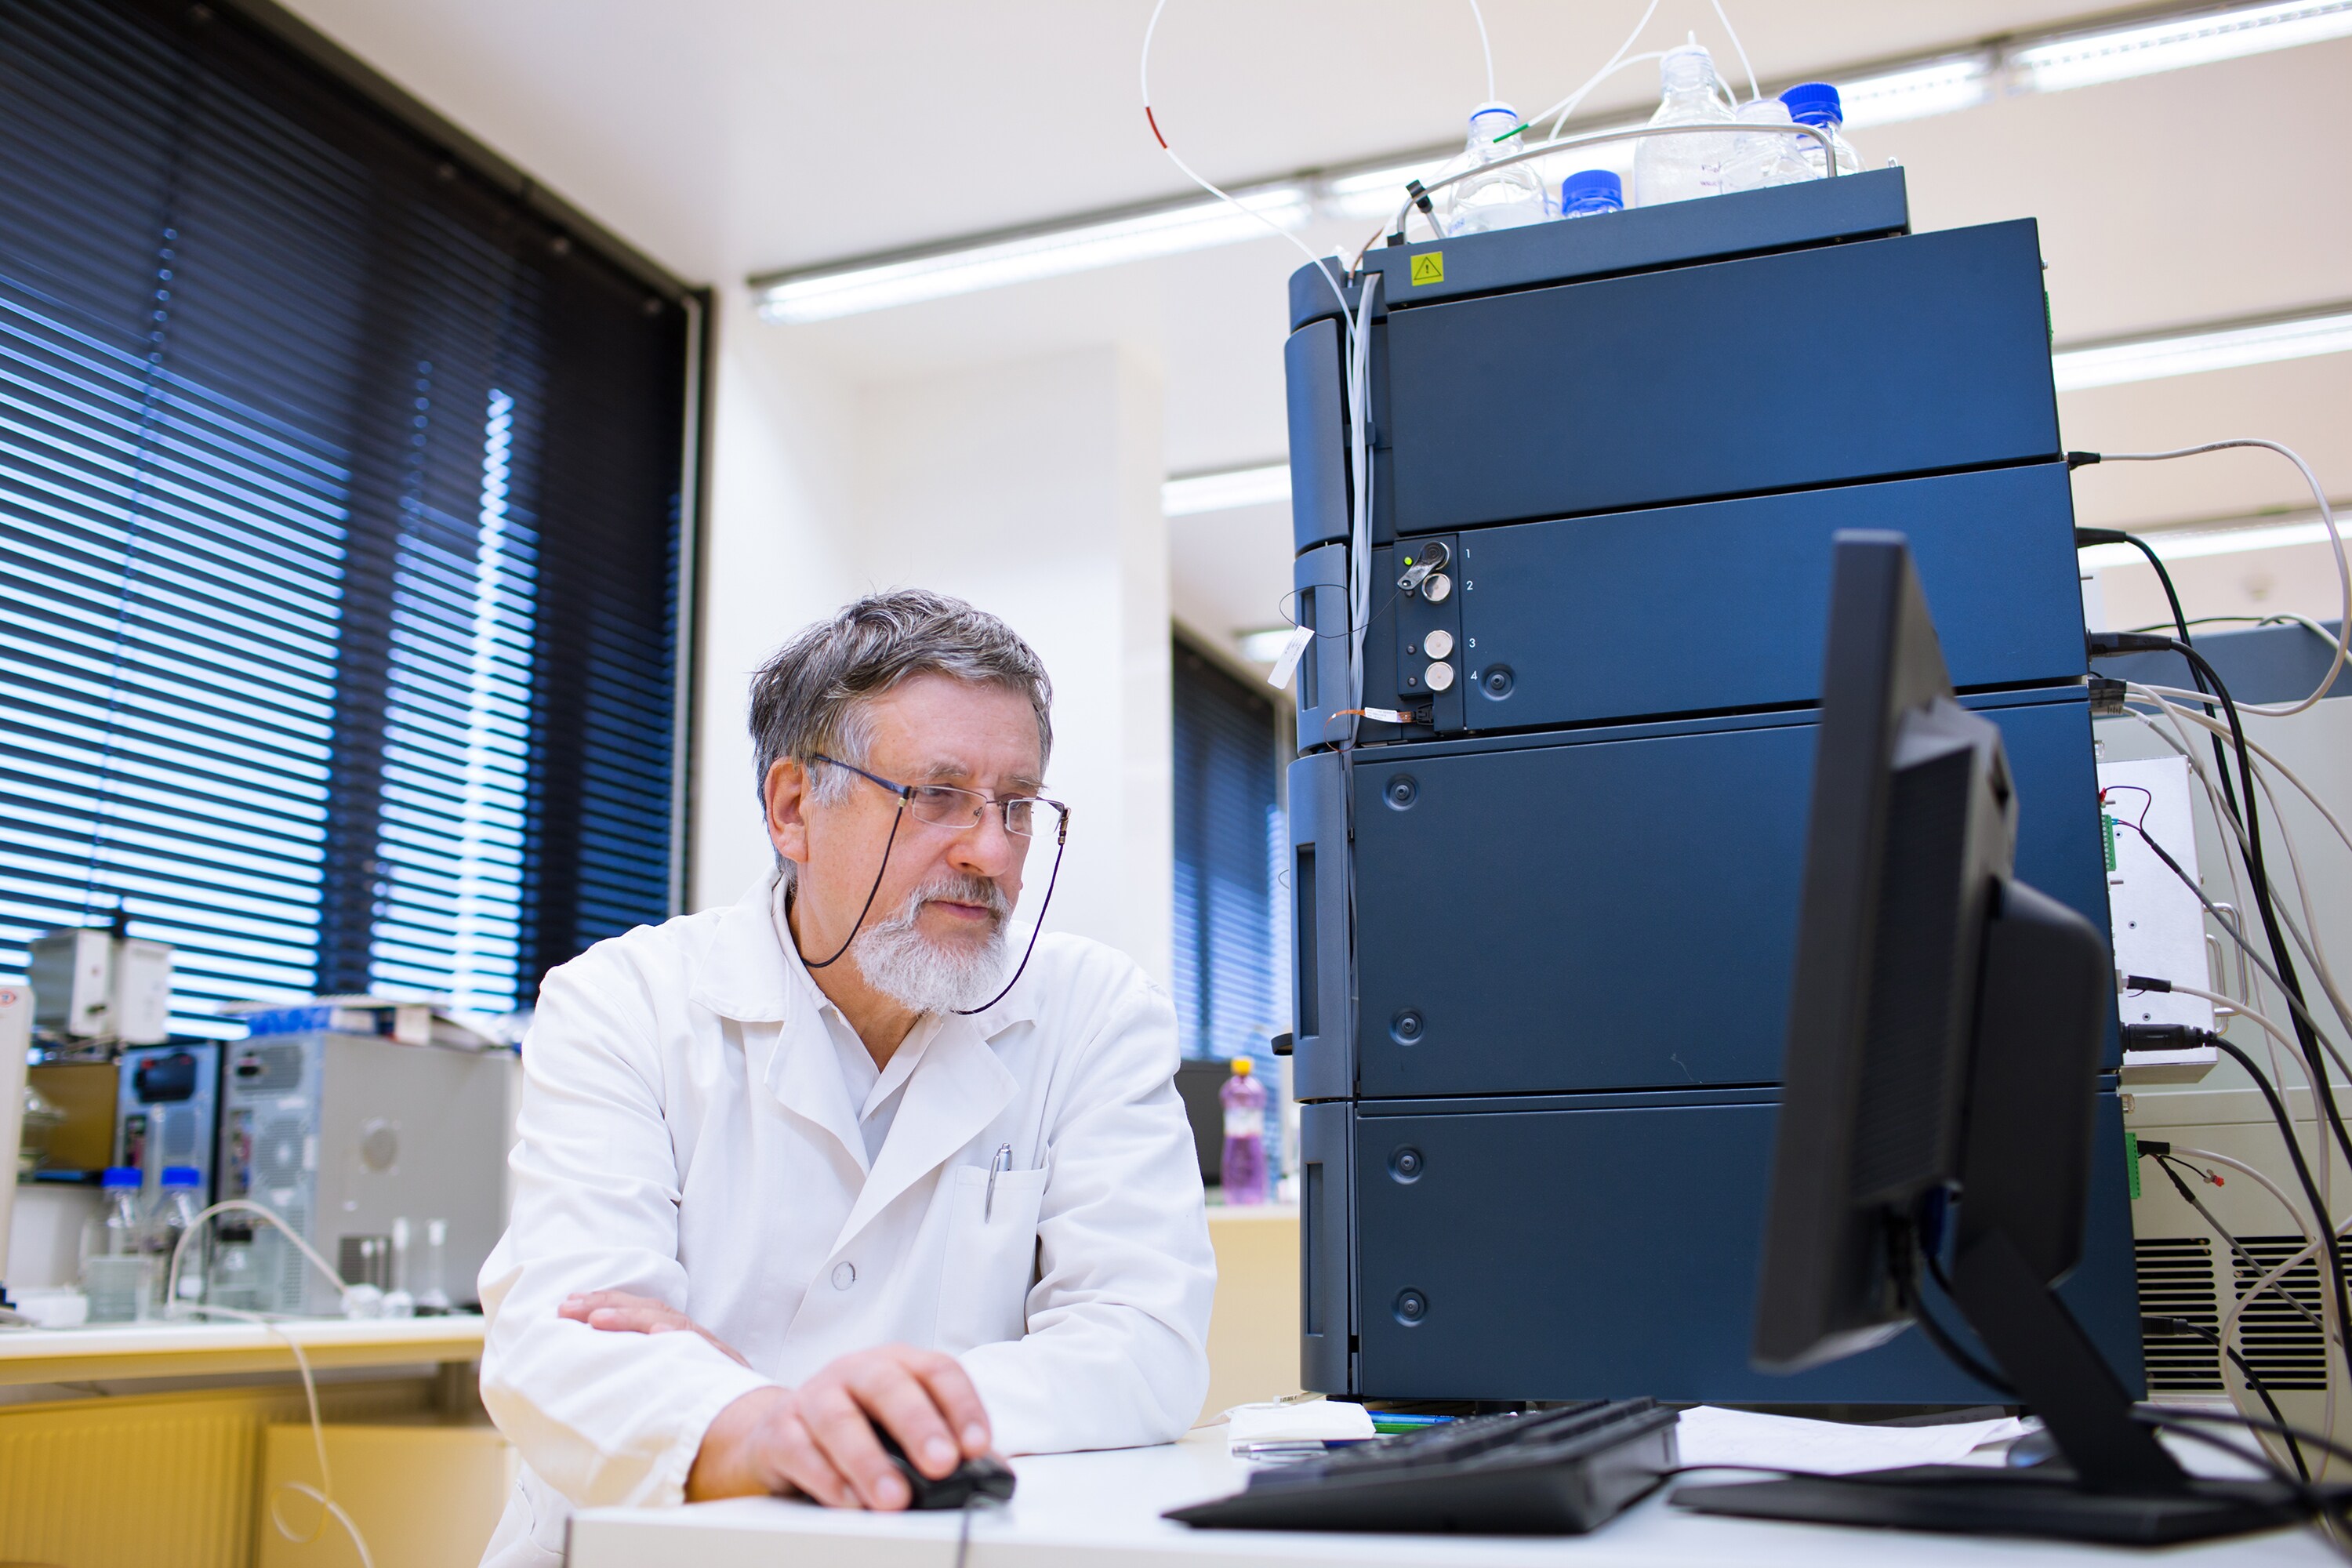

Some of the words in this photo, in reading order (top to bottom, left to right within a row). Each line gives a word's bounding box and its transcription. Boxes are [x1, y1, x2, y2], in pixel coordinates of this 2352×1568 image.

[1465, 549, 1470, 558] 1
[1466, 581, 1473, 590] 2
[1469, 638, 1475, 648] 3
[1471, 670, 1478, 681] 4
